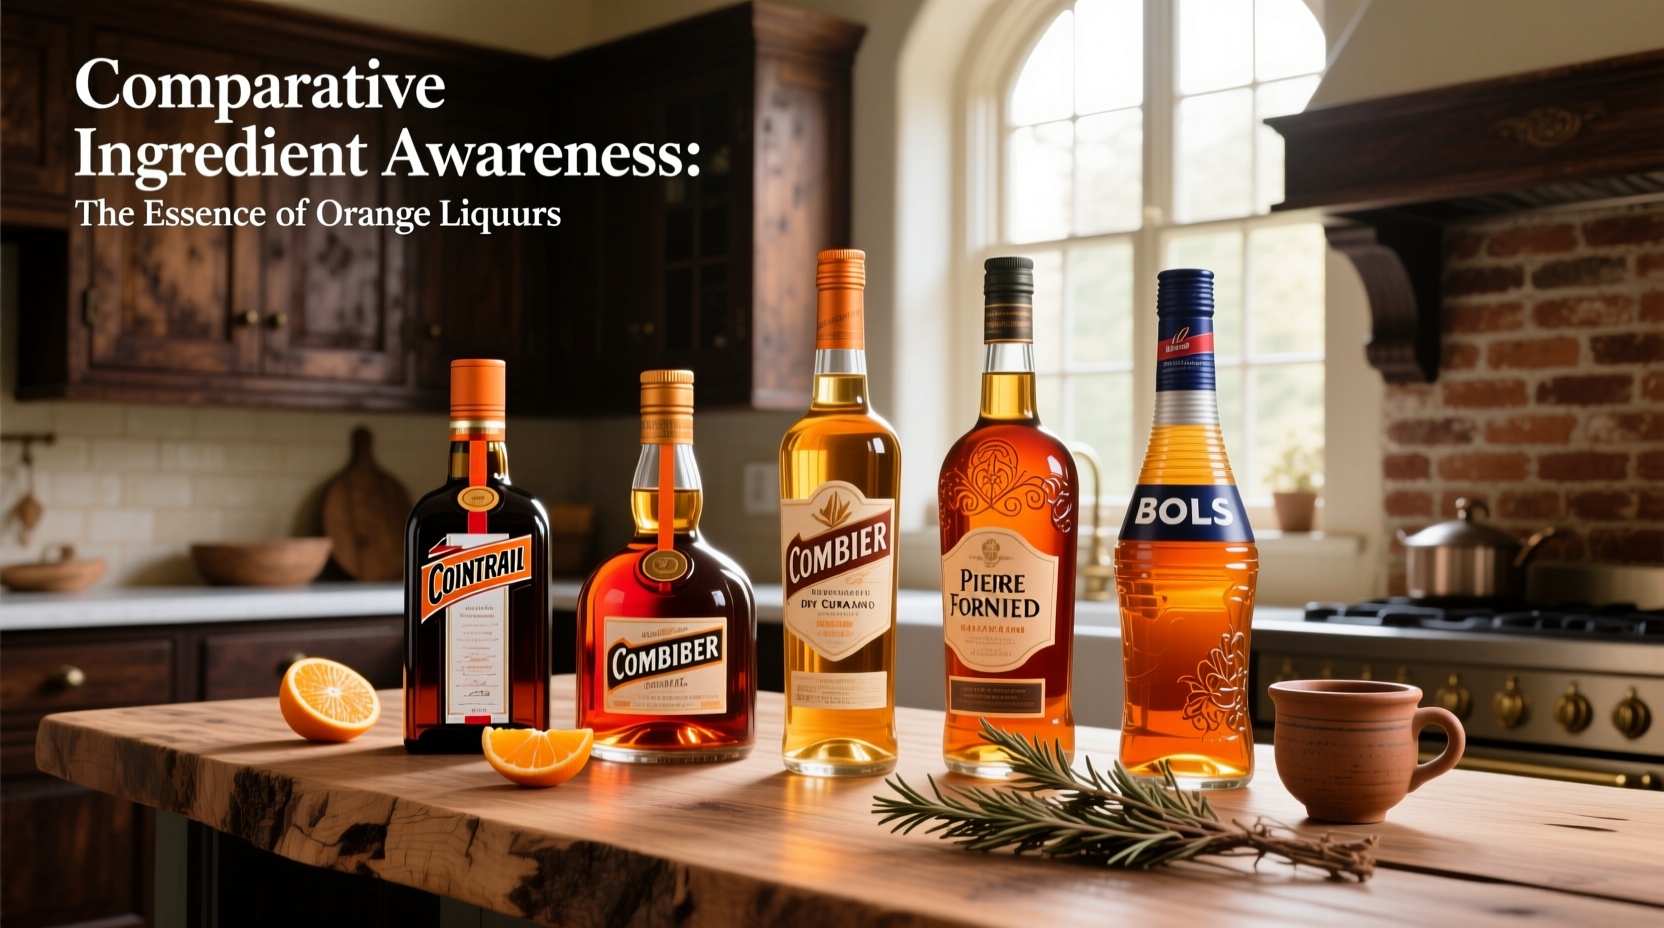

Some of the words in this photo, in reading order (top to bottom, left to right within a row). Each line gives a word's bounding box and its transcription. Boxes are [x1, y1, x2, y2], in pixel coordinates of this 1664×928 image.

[1134, 496, 1234, 527] BOLS
[788, 521, 888, 585] COMBIER
[428, 546, 525, 606] COINTRAIL
[950, 593, 1040, 618] FORNIED
[612, 635, 719, 680] COMBIBER
